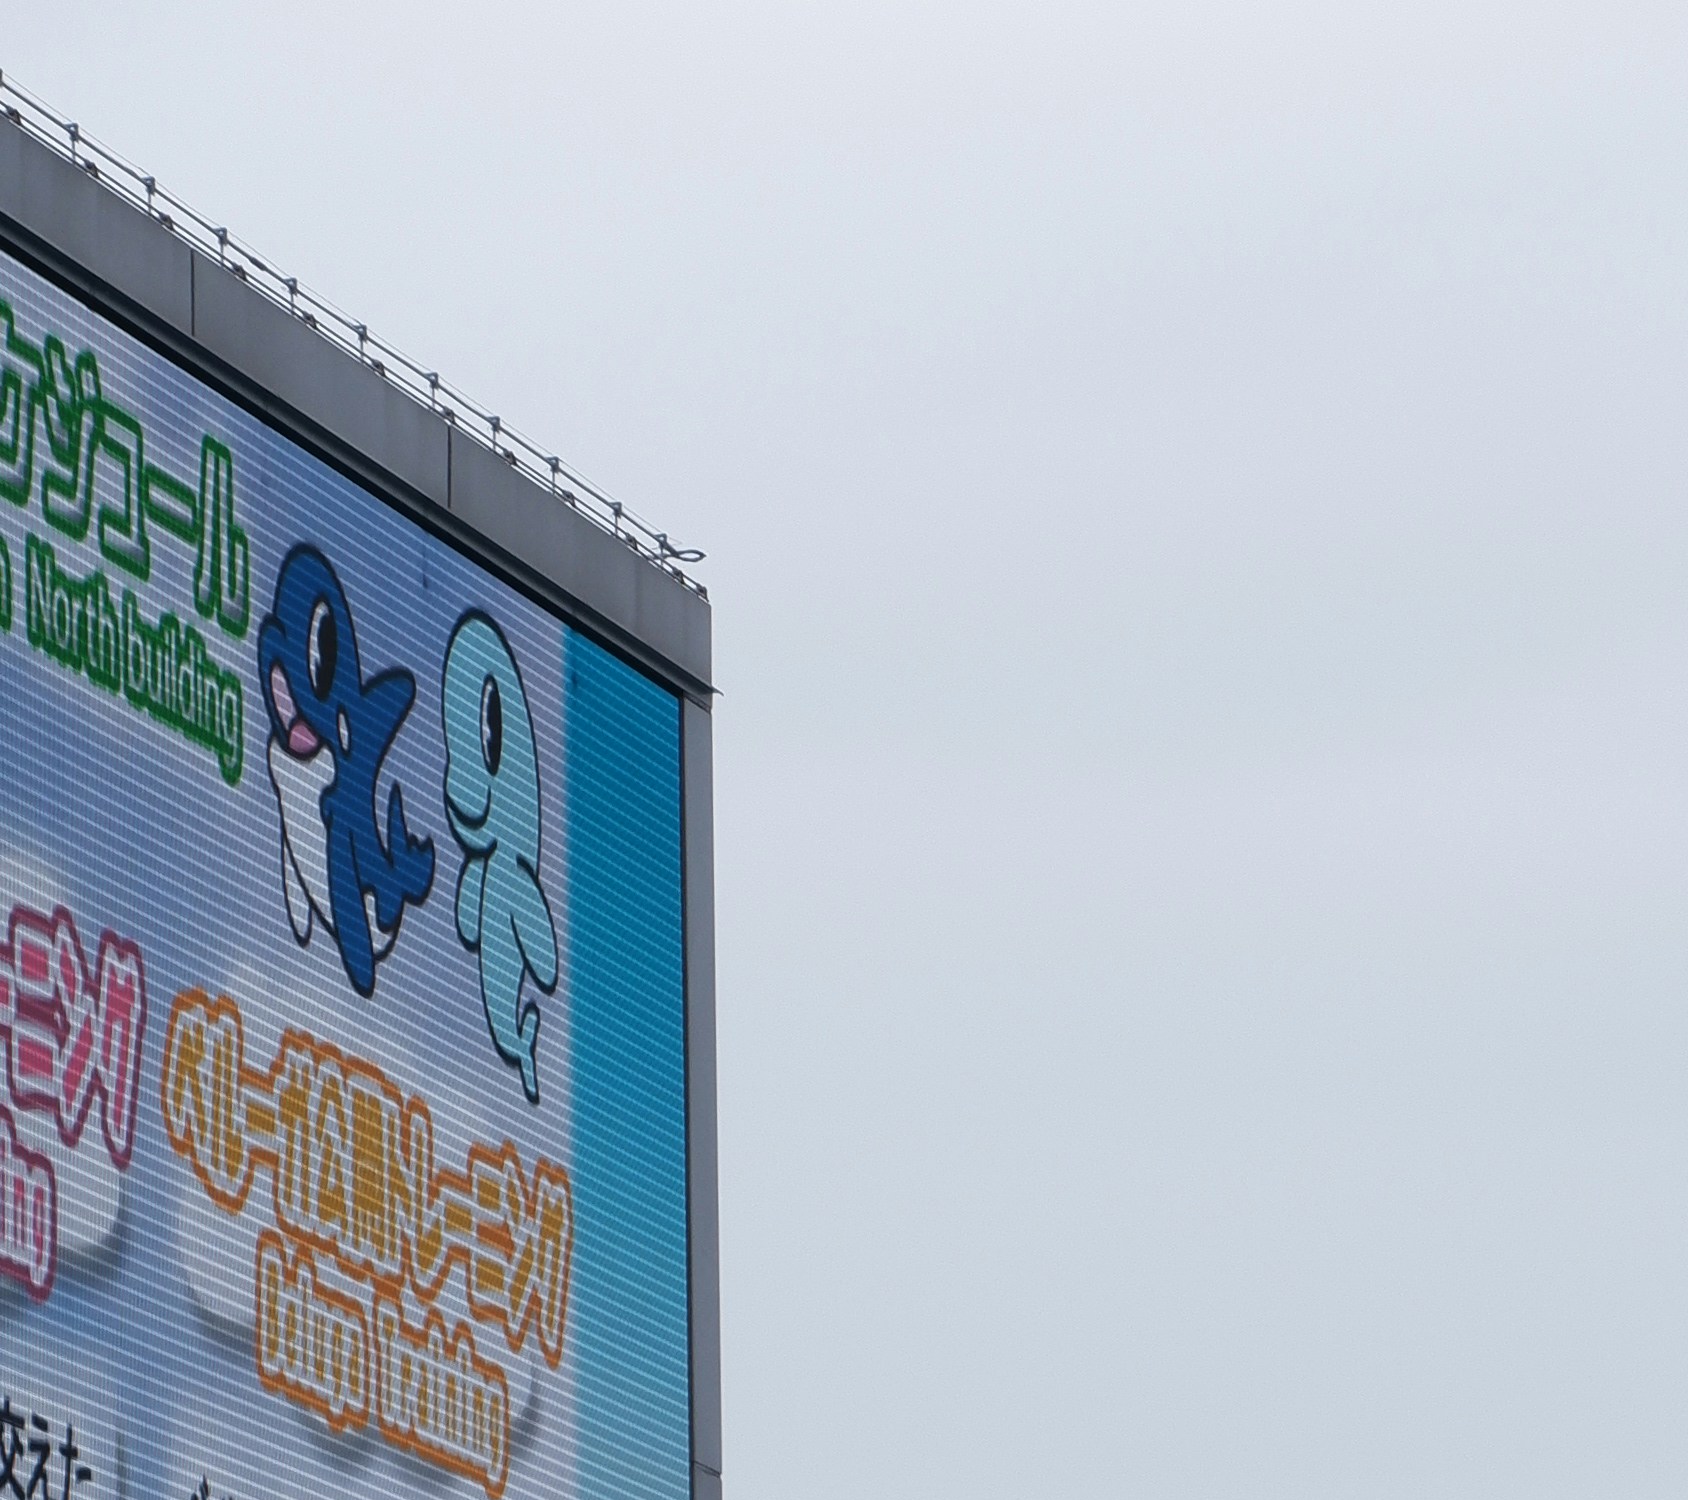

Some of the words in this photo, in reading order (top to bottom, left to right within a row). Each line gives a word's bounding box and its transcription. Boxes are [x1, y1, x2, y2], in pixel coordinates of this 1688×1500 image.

[27, 537, 119, 694] North
[123, 591, 242, 783] building
[161, 991, 573, 1370] ベルーガ公開トレーニング
[257, 1231, 368, 1431] Beluga
[374, 1278, 508, 1500] training
